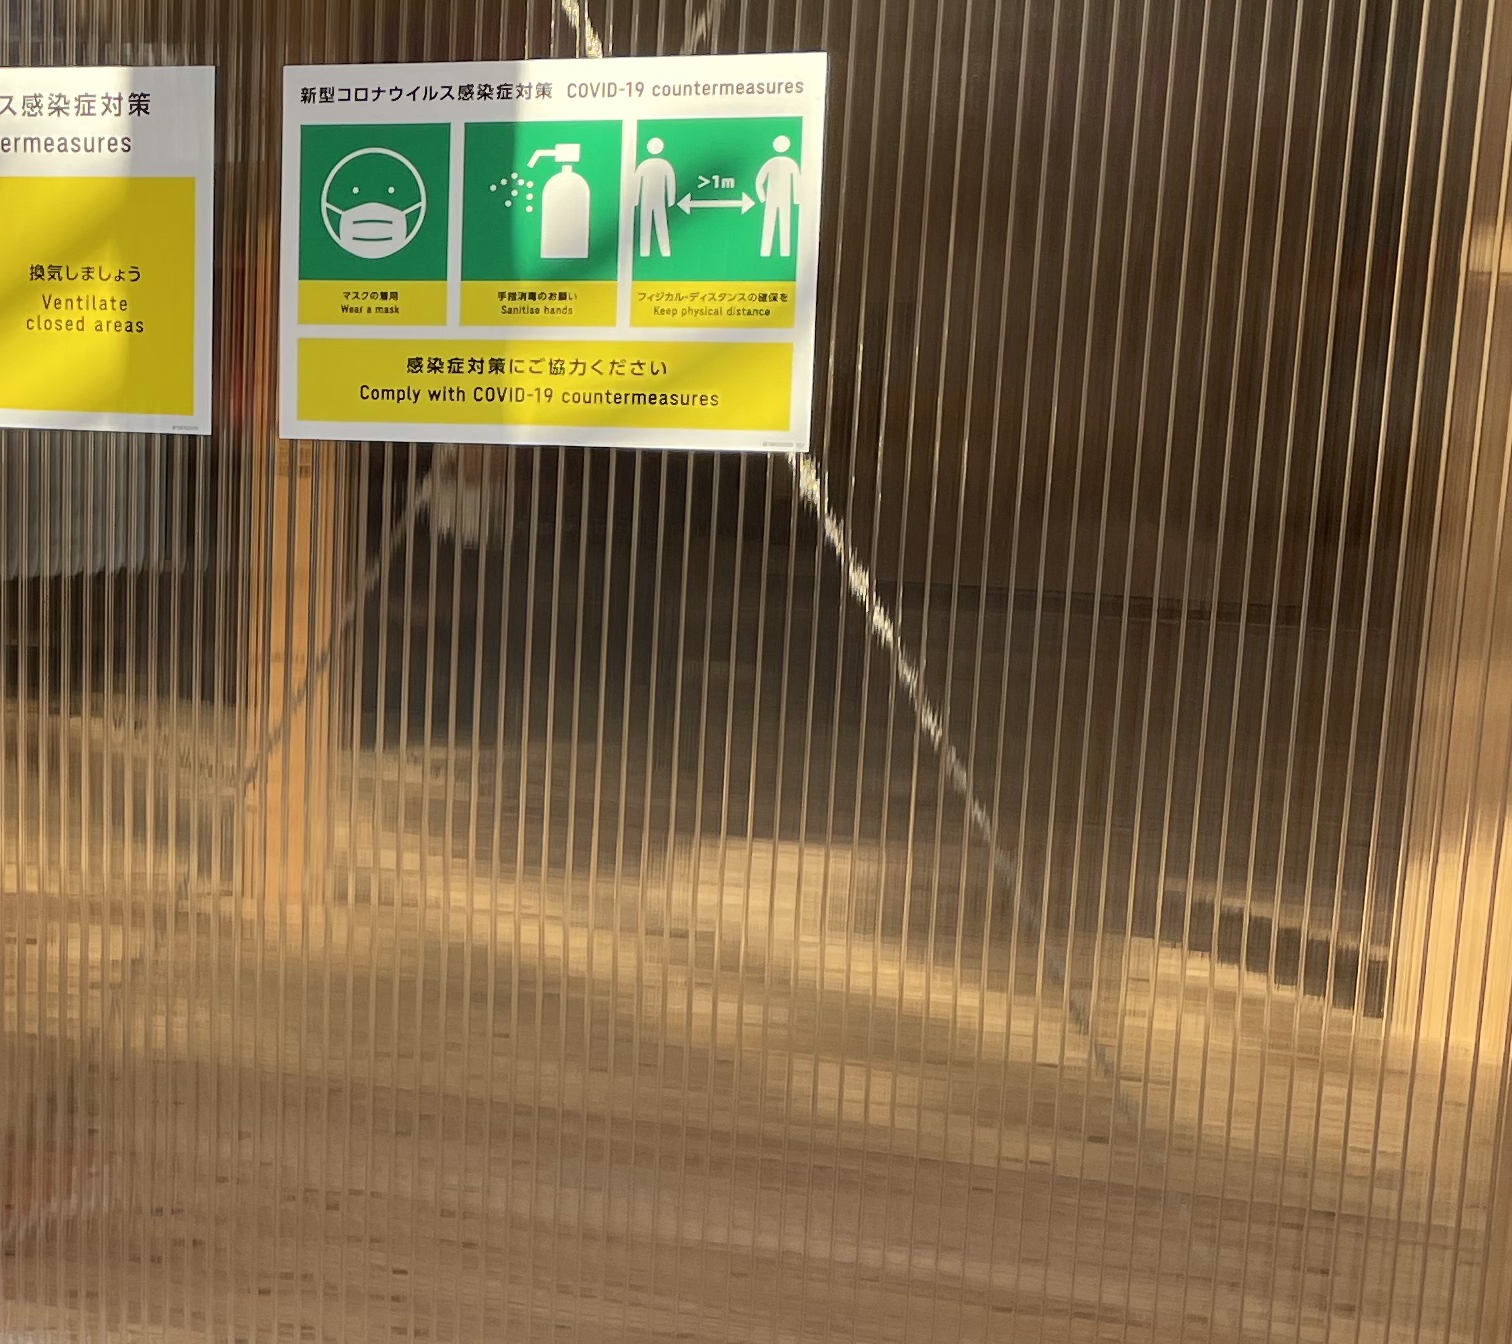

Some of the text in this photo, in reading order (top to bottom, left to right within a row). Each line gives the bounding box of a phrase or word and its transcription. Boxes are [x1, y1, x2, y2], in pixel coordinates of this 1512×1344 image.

[300, 79, 804, 105] 新型コロナウイルス感染症対策 COVID-19 countermeasures
[29, 263, 141, 282] 換気しましょう
[41, 294, 128, 311] Ventilate
[340, 304, 400, 314] Wear a mask
[544, 305, 573, 315] hands
[653, 306, 771, 317] Keep physical distance
[26, 314, 144, 333] closed areas
[406, 356, 668, 376] 感染症対策にご協力ください
[359, 384, 719, 406] Comply with COVID-19 countermeasures
